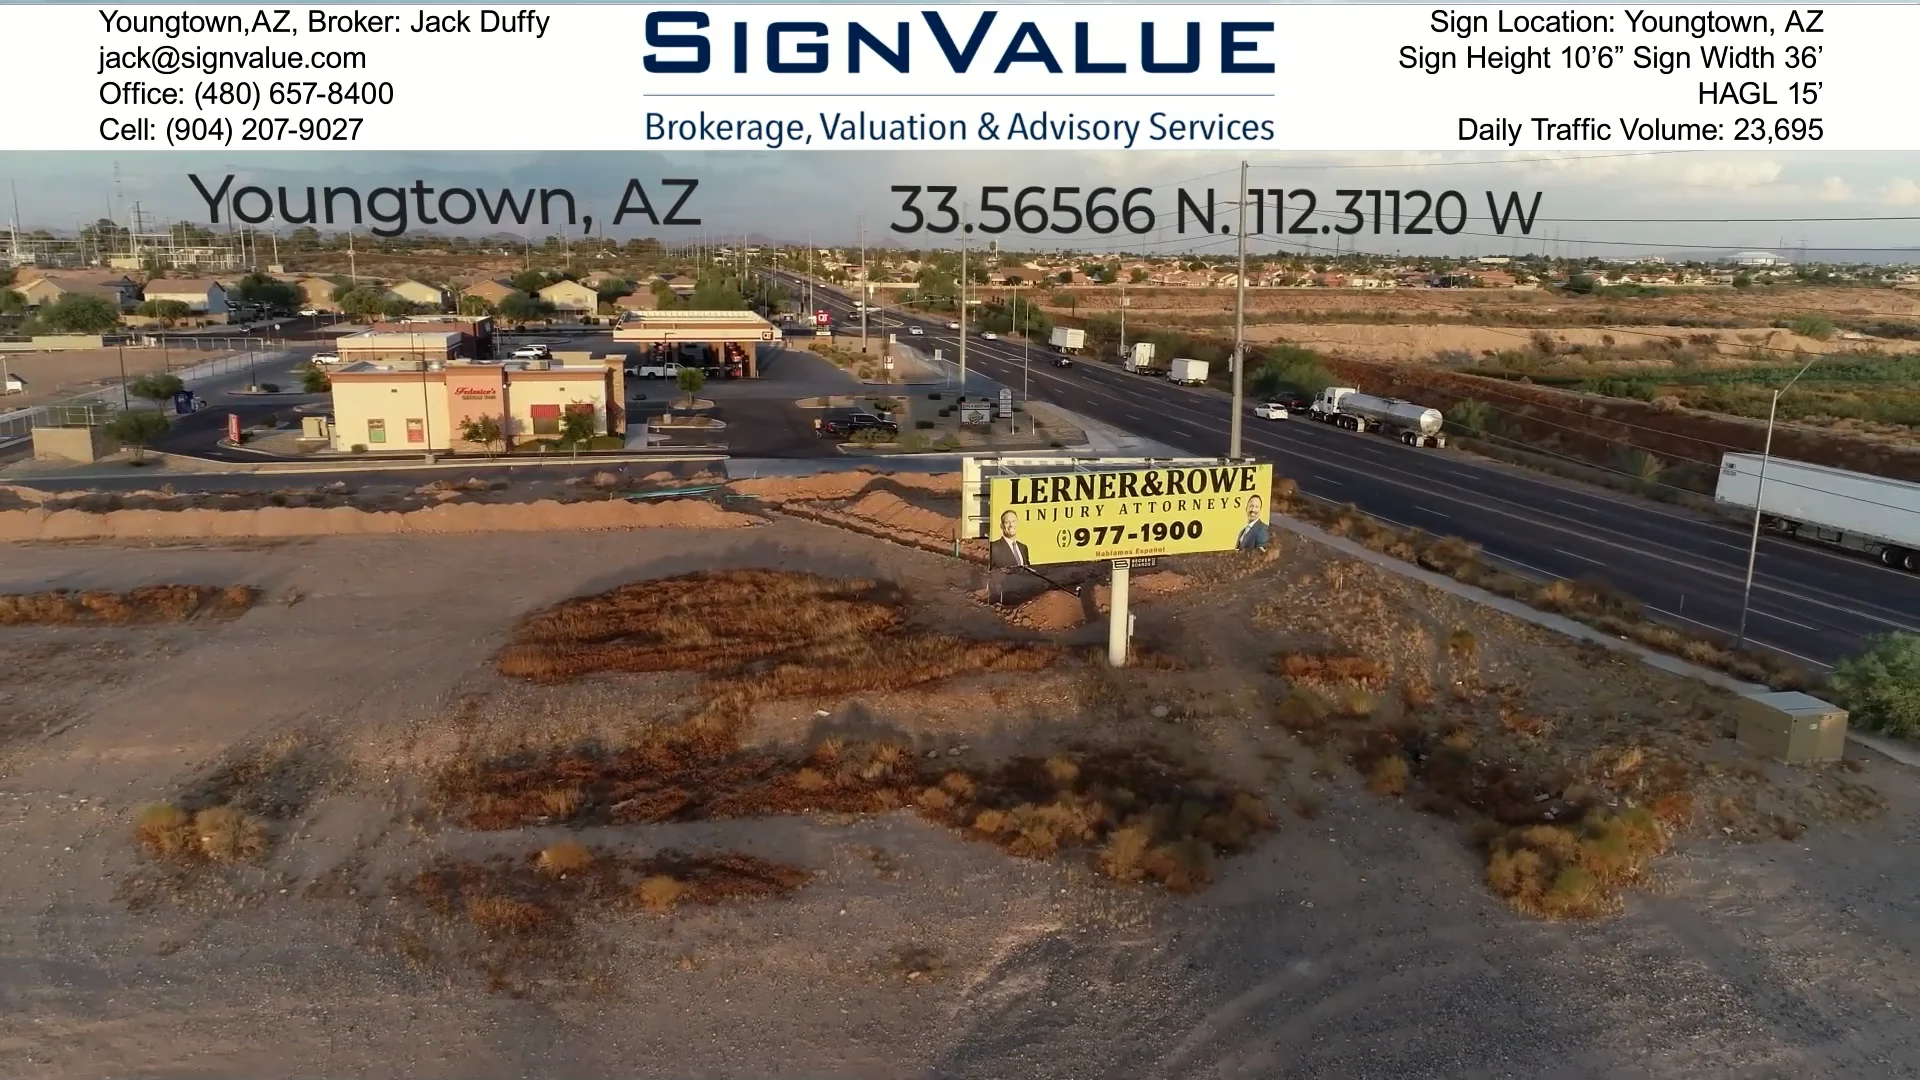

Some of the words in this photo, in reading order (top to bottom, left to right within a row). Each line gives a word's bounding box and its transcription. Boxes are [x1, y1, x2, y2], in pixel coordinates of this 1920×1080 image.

[1009, 466, 1258, 506] LERNER&ROWE
[1025, 504, 1105, 523] INJURY
[1119, 495, 1243, 516] ATTORNEYS
[1095, 549, 1133, 557] Hablamos
[1135, 547, 1166, 555] Español
